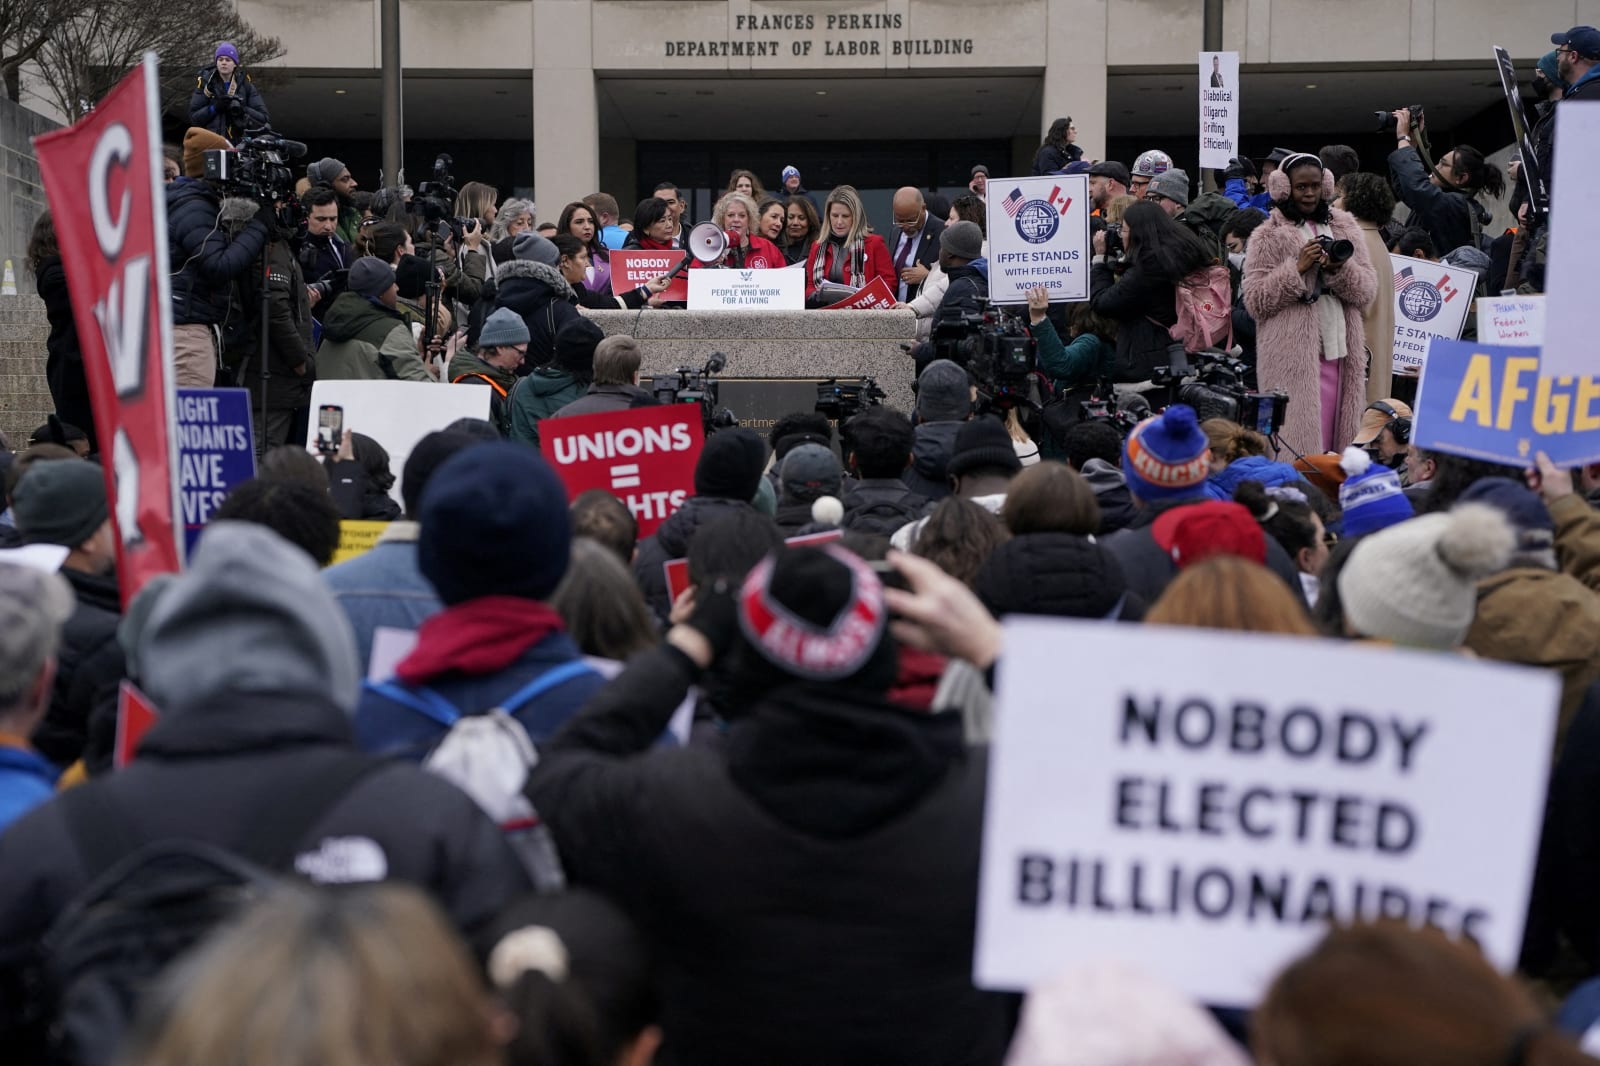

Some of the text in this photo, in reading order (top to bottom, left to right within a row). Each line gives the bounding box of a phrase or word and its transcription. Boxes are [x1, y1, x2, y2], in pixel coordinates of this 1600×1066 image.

[736, 13, 902, 30] FRANCES PERKINS
[665, 39, 973, 57] DEPARTMENT OF LABOR BUILDING
[1203, 90, 1232, 102] Diabolical
[1203, 106, 1228, 120] Oligarch
[1203, 137, 1232, 153] Efficiently
[625, 258, 671, 268] NOBODY
[997, 250, 1079, 263] IFPTE STANDS
[1005, 266, 1072, 276] WITH FEDERAL
[711, 288, 781, 297] PEOPLE WHO WORK
[722, 296, 769, 305] FOR A LIVING
[853, 293, 877, 309] THE
[1402, 341, 1425, 353] FEDE
[1392, 353, 1424, 366] ORKER
[178, 396, 219, 422] IGHT
[178, 424, 248, 451] NDANTS
[553, 422, 691, 464] UNIONS
[181, 453, 226, 488] AVE
[1120, 692, 1430, 774] NOBODY
[1113, 776, 1419, 855] ELECTED
